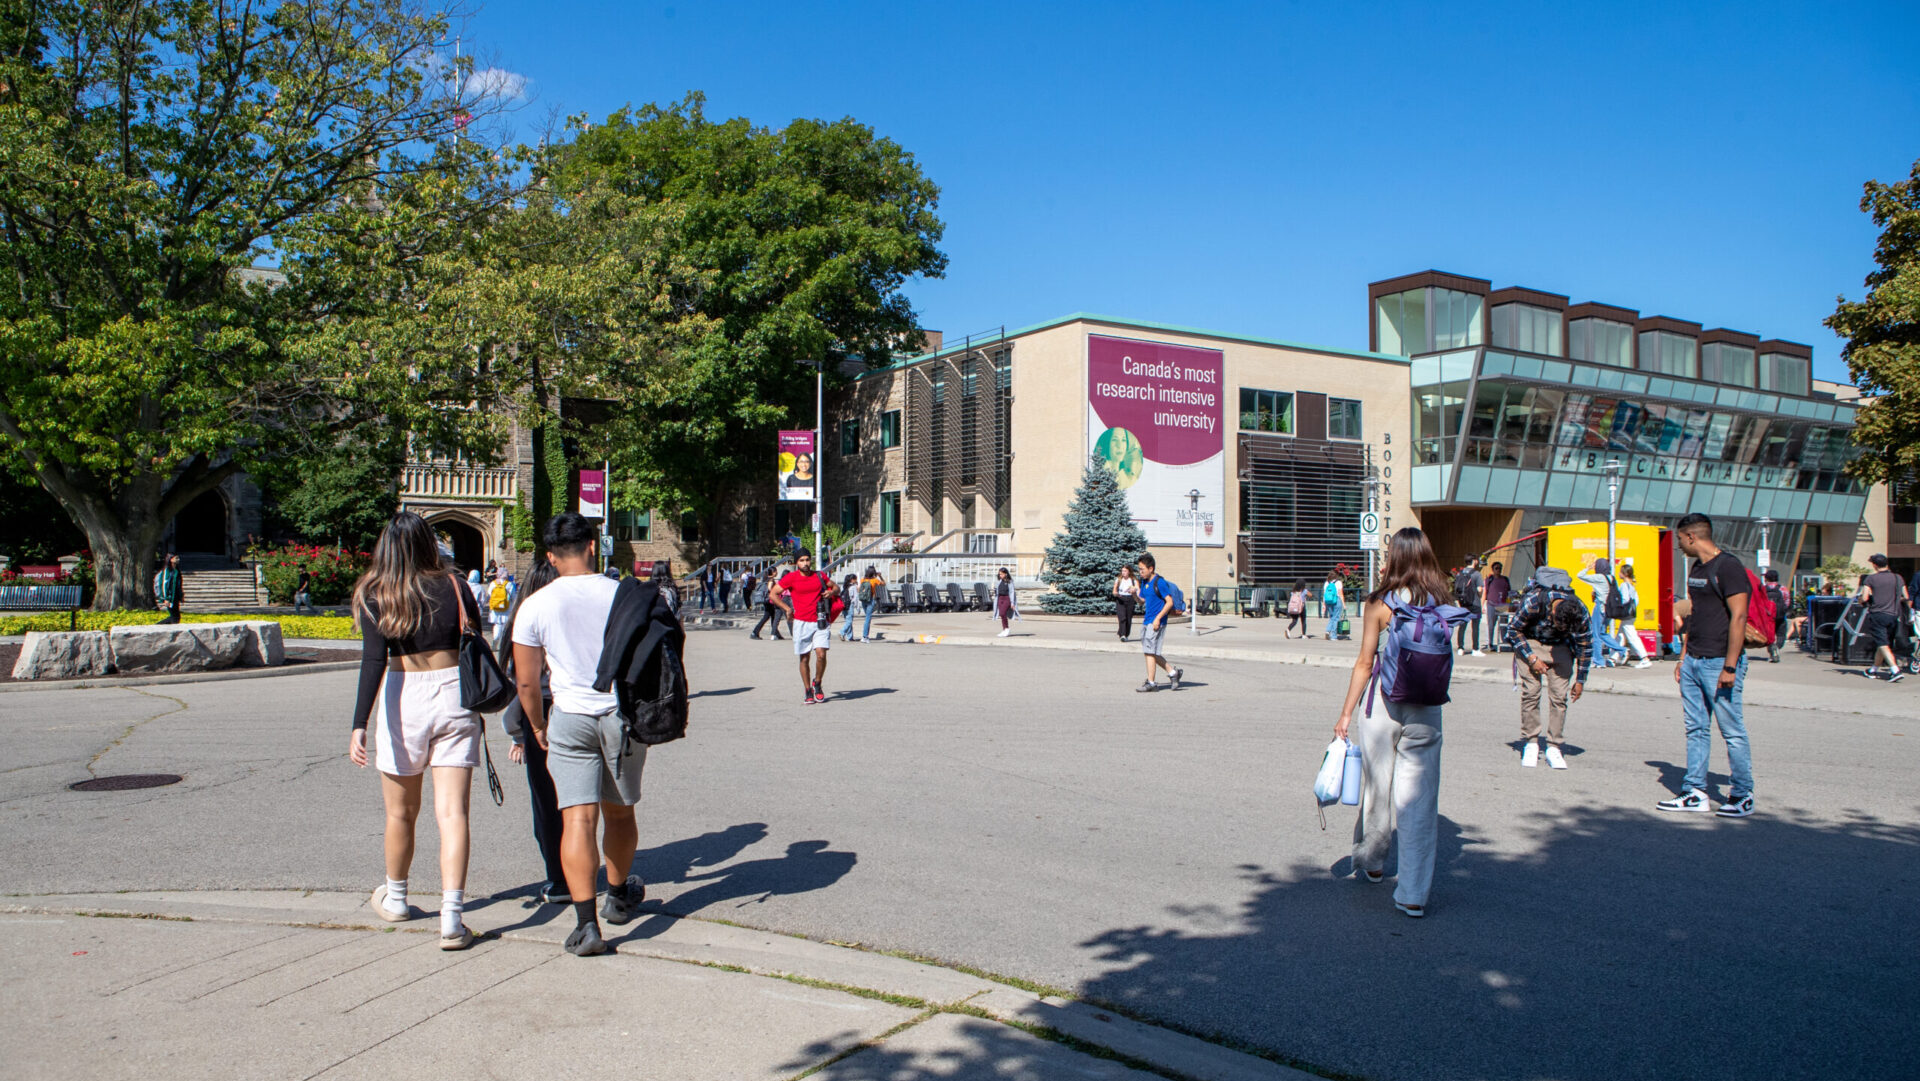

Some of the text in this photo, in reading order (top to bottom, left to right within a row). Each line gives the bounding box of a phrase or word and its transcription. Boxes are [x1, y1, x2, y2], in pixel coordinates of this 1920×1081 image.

[1122, 356, 1216, 383] Canada's most
[1097, 382, 1215, 406] research intensive
[1154, 409, 1216, 434] university
